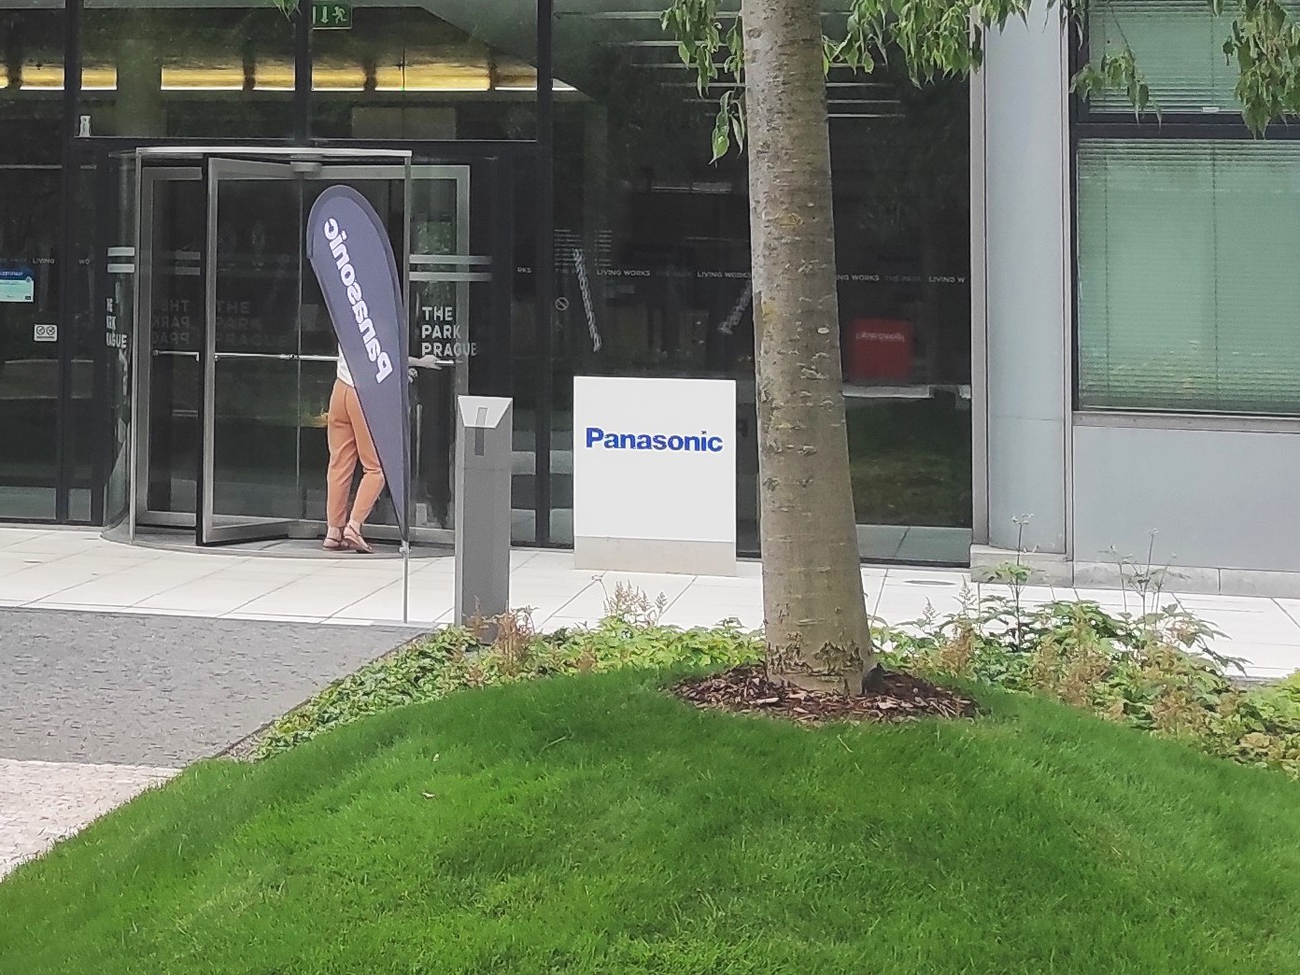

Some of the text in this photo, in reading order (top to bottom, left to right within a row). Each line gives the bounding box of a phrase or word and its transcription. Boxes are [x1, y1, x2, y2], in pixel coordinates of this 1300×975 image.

[697, 270, 723, 278] LIVING
[851, 274, 880, 282] WORKS
[421, 305, 453, 321] THE
[421, 324, 462, 339] PARK
[421, 342, 477, 357] PRAGUE
[585, 427, 724, 452] Panasonic
